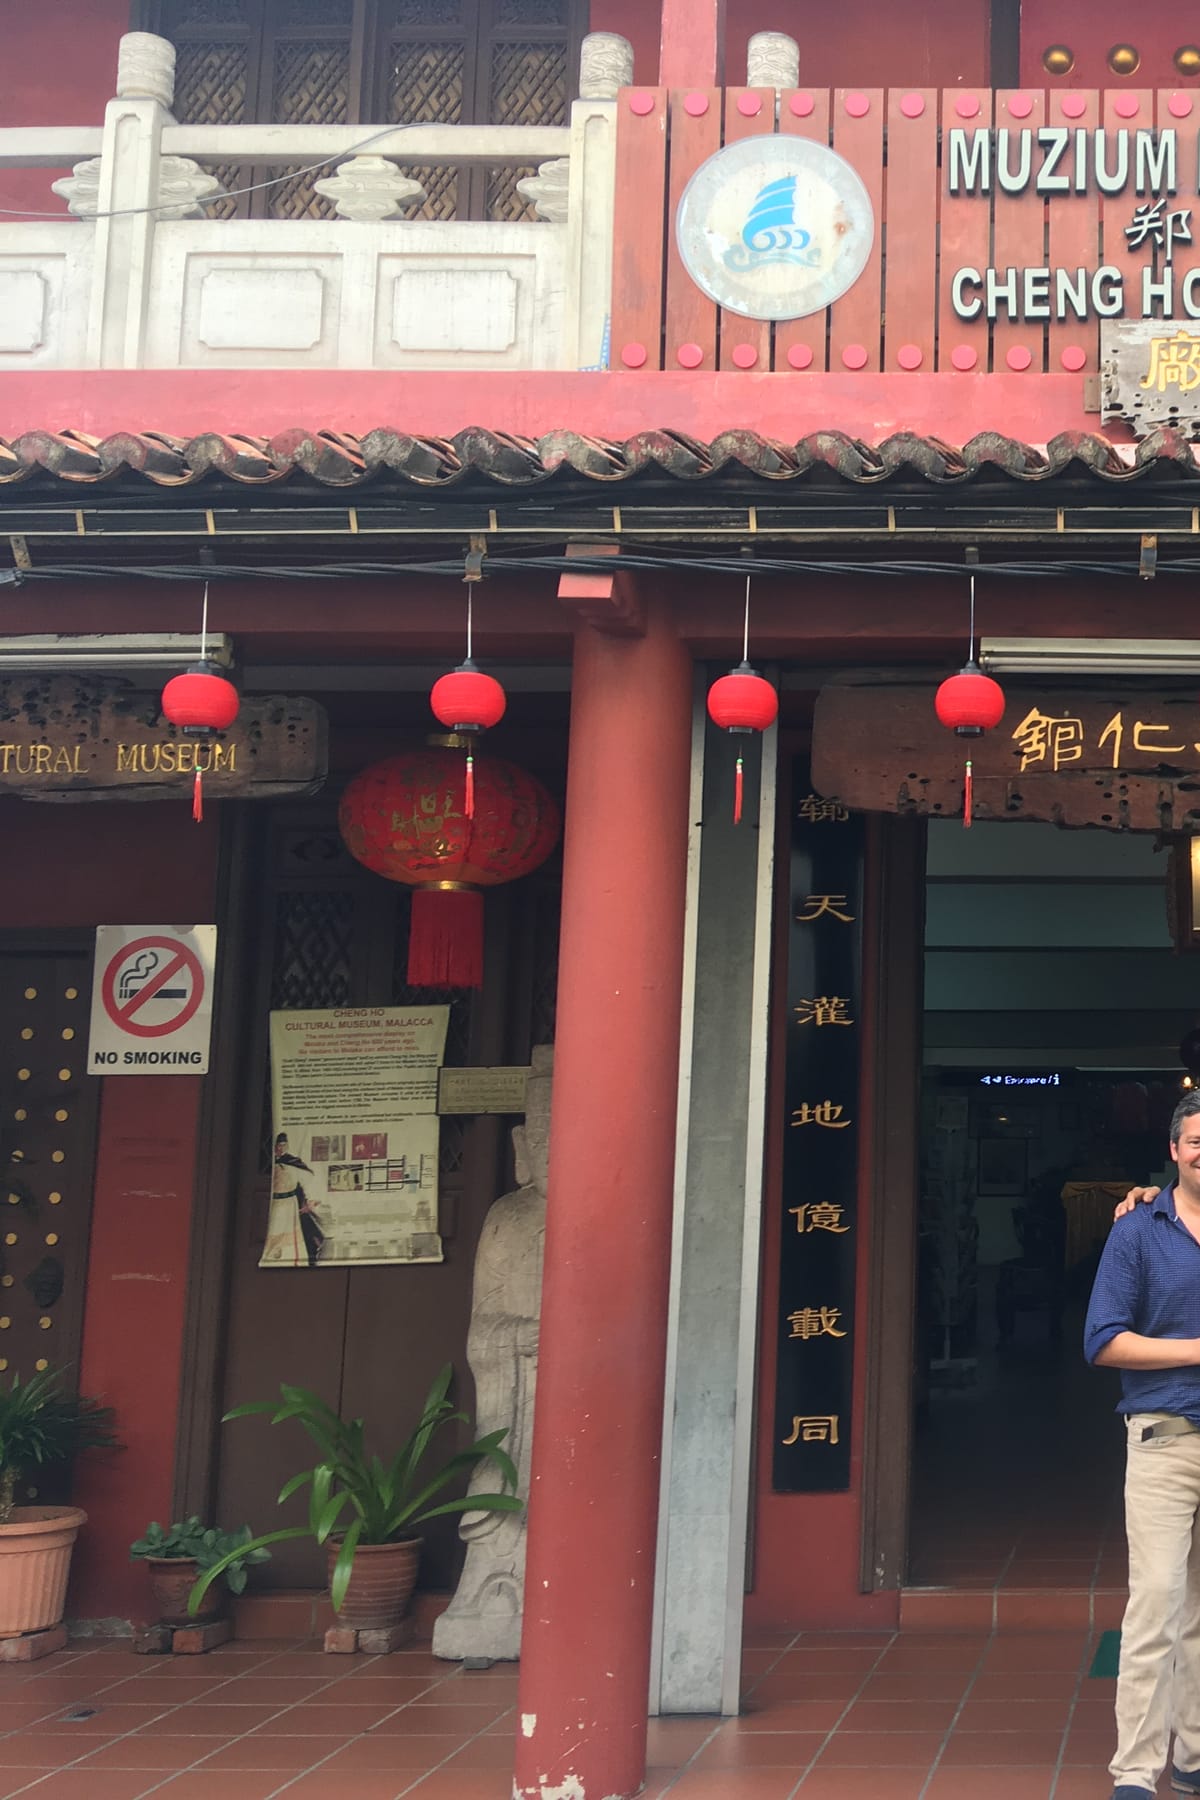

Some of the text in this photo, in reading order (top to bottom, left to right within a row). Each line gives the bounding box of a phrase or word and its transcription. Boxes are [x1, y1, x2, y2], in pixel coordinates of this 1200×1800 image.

[949, 127, 1177, 196] MUZIUM
[951, 265, 1124, 321] CHENG
[115, 742, 237, 773] MUSEUM
[285, 1022, 336, 1031] CULTURAL
[385, 1018, 434, 1027] MALACCA
[333, 1009, 385, 1018] CHENG HO
[94, 1051, 203, 1065] NO SMOKING
